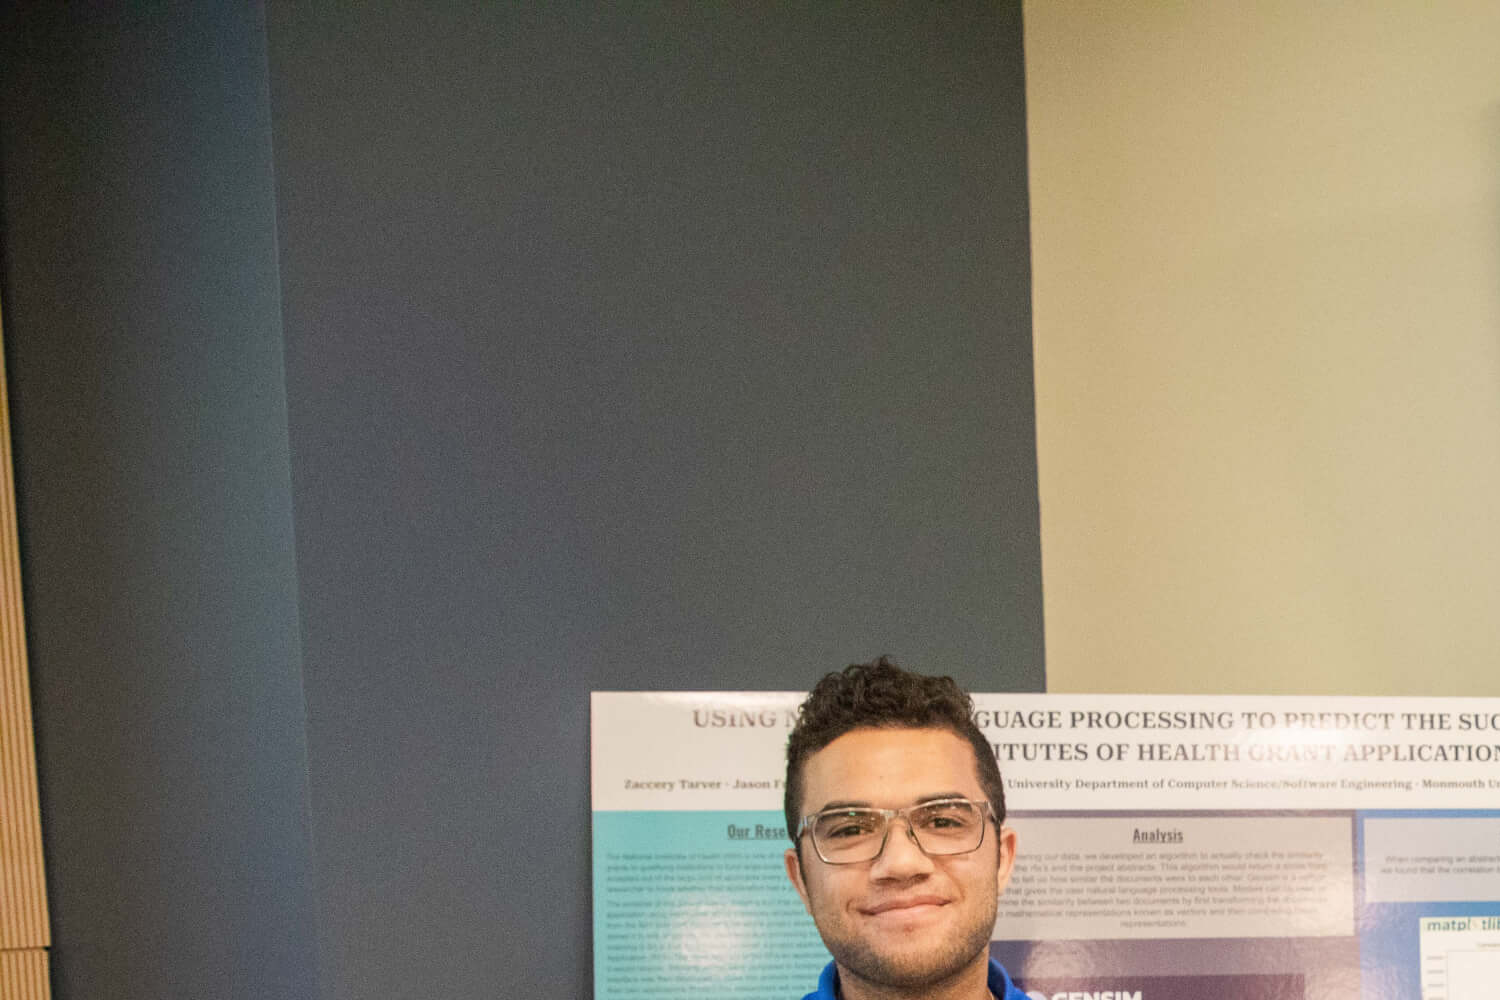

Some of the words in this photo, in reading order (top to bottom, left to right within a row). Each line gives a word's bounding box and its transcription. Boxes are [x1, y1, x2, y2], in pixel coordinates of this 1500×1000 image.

[692, 709, 777, 729] USING
[974, 710, 1062, 729] GUAGE
[1069, 710, 1235, 731] PROCESSING
[1241, 711, 1277, 731] TO
[1283, 712, 1395, 731] PREDICT
[1401, 712, 1452, 732] THE
[994, 743, 1089, 761] ITUTES
[1096, 743, 1132, 762] OF
[1137, 743, 1240, 762] HEALTH
[1248, 743, 1336, 762] GRANT
[624, 779, 674, 793] Zaccery
[680, 779, 721, 790] Tarver
[732, 779, 770, 790] Jason
[1007, 778, 1070, 790] University
[1075, 778, 1148, 791] Department
[1152, 778, 1164, 789] of
[1167, 778, 1226, 791] Computer
[1340, 779, 1412, 791] Engineering
[1422, 779, 1485, 790] Monmouth
[727, 825, 750, 840] Our
[755, 825, 786, 840] Rese
[1133, 828, 1183, 843] Analysis
